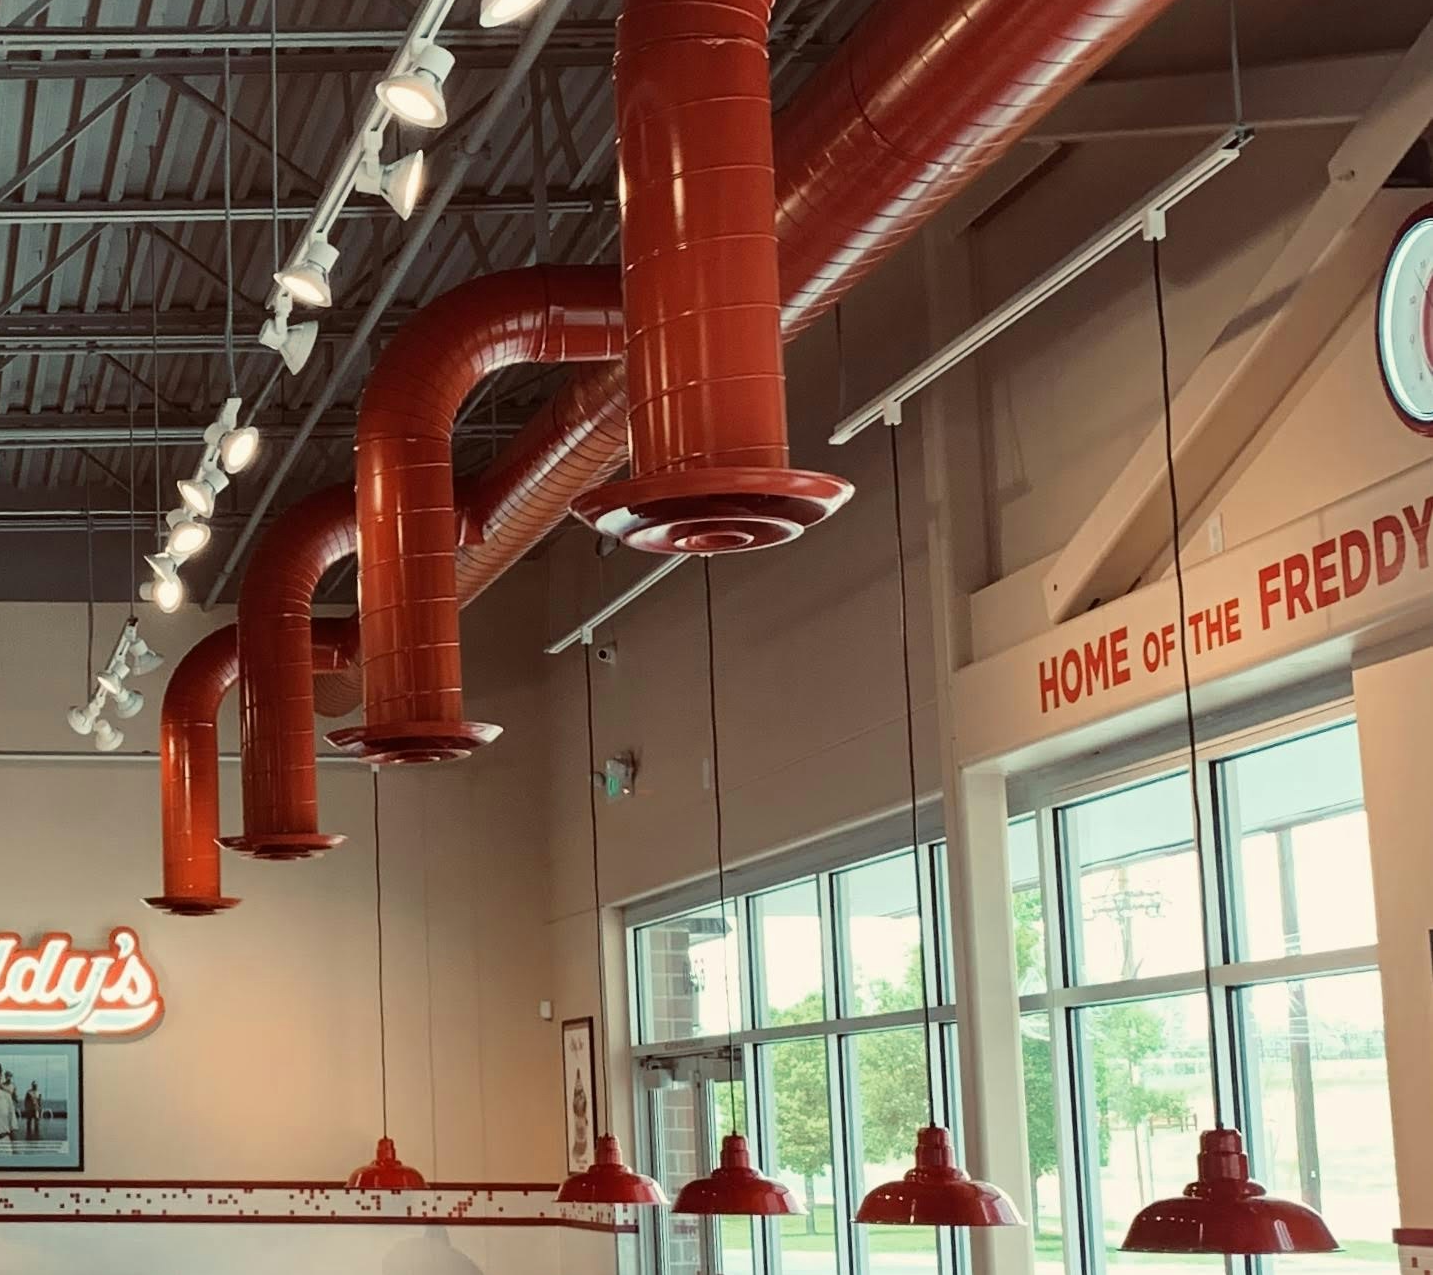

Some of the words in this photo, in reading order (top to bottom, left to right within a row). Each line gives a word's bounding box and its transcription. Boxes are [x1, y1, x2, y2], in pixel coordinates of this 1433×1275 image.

[1039, 626, 1131, 713] HOME
[1143, 623, 1176, 673] OF
[1188, 597, 1242, 655] THE
[1258, 495, 1433, 631] FREDDY
